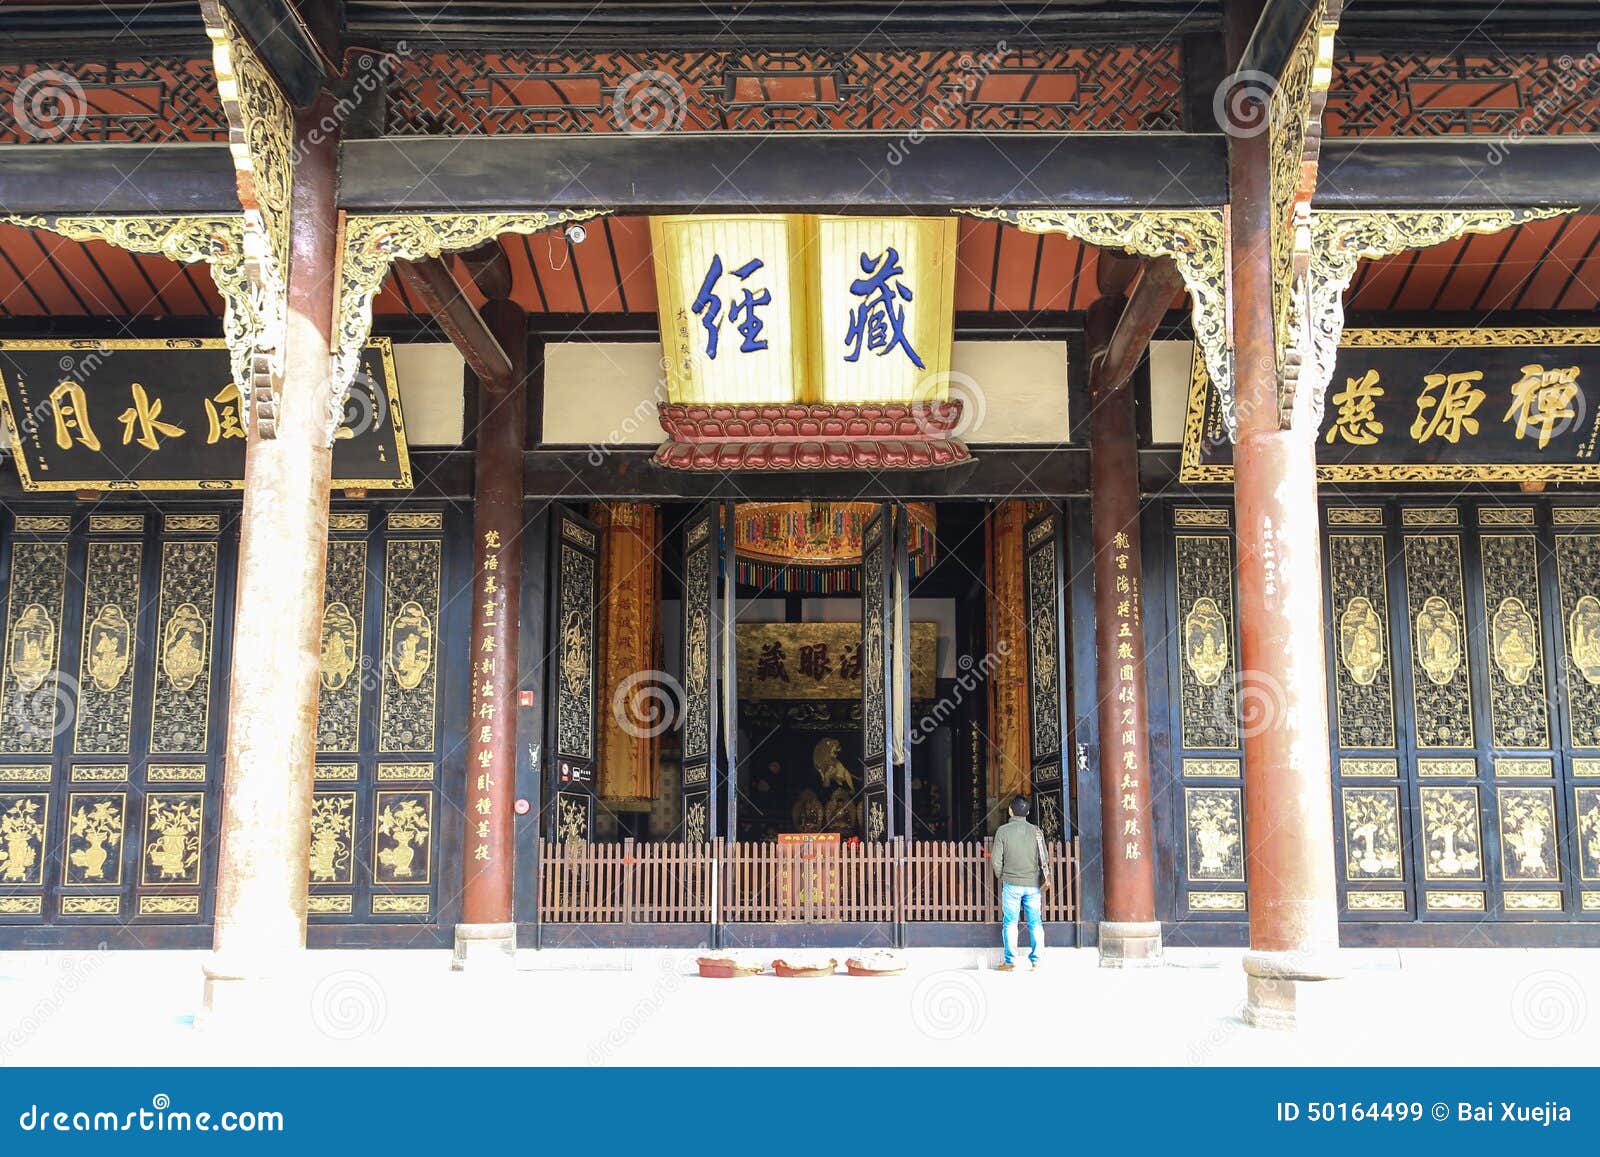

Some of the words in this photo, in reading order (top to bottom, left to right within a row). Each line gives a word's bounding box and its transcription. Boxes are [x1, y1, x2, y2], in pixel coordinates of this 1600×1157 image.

[691, 247, 926, 370] 藏經
[1326, 364, 1581, 450] 禪源慈
